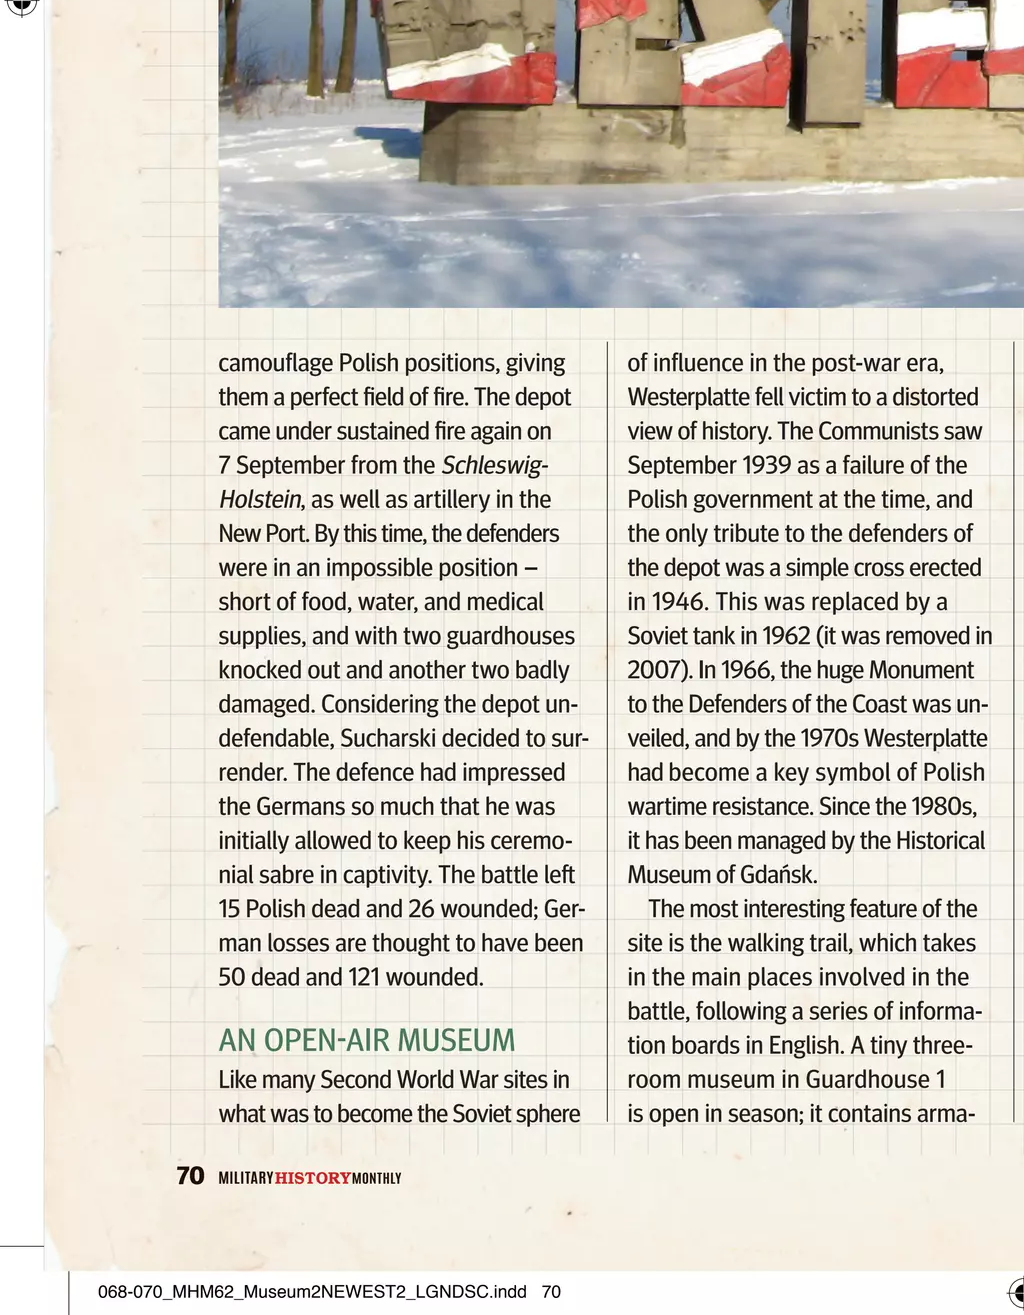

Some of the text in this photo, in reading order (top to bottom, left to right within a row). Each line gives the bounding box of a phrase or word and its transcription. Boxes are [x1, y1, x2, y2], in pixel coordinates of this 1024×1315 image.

[219, 352, 565, 376] camouflage Polish positions, giving
[628, 352, 943, 376] of influence in the post-war era,
[219, 455, 548, 479] 7 September from the Schleswig-
[628, 455, 967, 478] September 1939 as a failure of the
[219, 728, 588, 750] defendable, Sucharski decided to sur-
[628, 728, 987, 751] veiled, and by the 1970s Westerplatte
[219, 967, 483, 986] 50 dead and 121 wounded.
[219, 1028, 514, 1051] AN OPEN-AIR MUSEUM
[628, 1035, 972, 1059] tion boards in English. A tiny three-
[220, 1069, 569, 1093] Like many Second World War sites in
[177, 1166, 204, 1185] 70
[99, 1285, 561, 1300] 068-070_MHM62_Museum2NEWEST2_LGNDSC.indd 70
